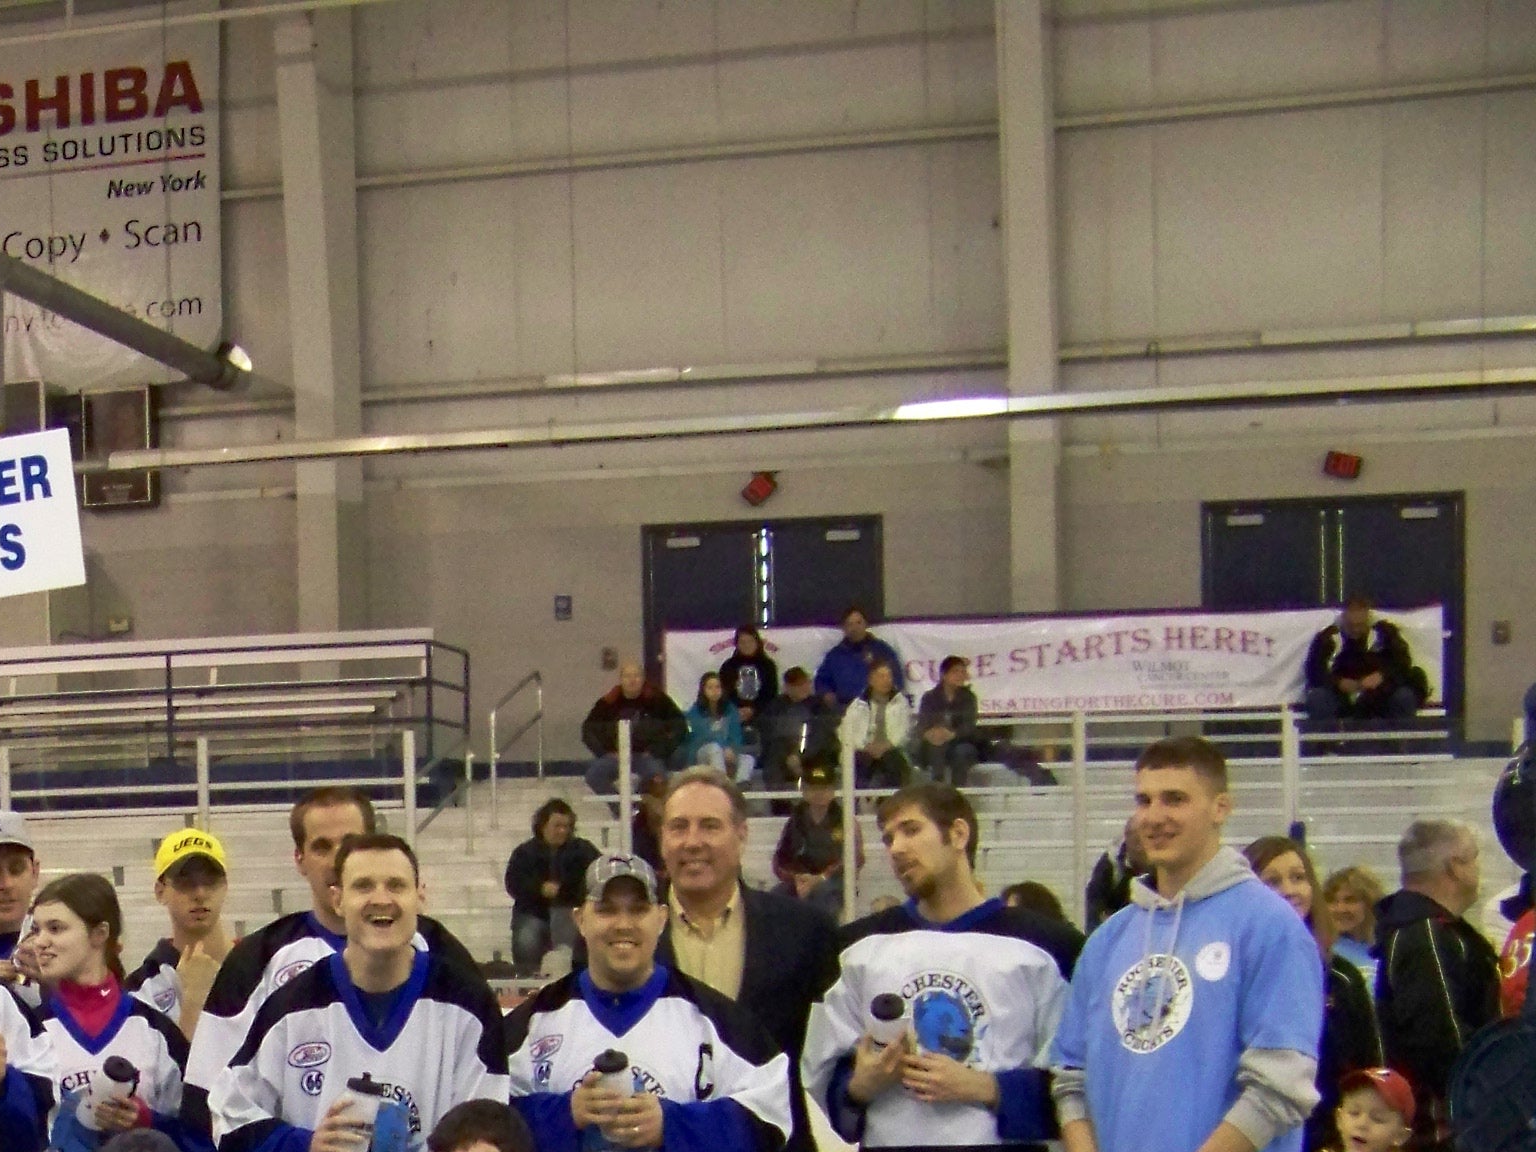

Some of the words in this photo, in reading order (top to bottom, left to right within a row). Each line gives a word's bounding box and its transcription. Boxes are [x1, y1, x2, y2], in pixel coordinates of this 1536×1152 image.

[43, 126, 206, 163] SOLUTIONS
[107, 178, 154, 199] New
[160, 170, 207, 194] York
[3, 232, 87, 269] Copy
[124, 218, 203, 250] Scan
[905, 653, 997, 684] CUE
[1009, 627, 1152, 673] STARTS
[1165, 625, 1276, 658] HERE!
[901, 973, 986, 1019] CHESTER
